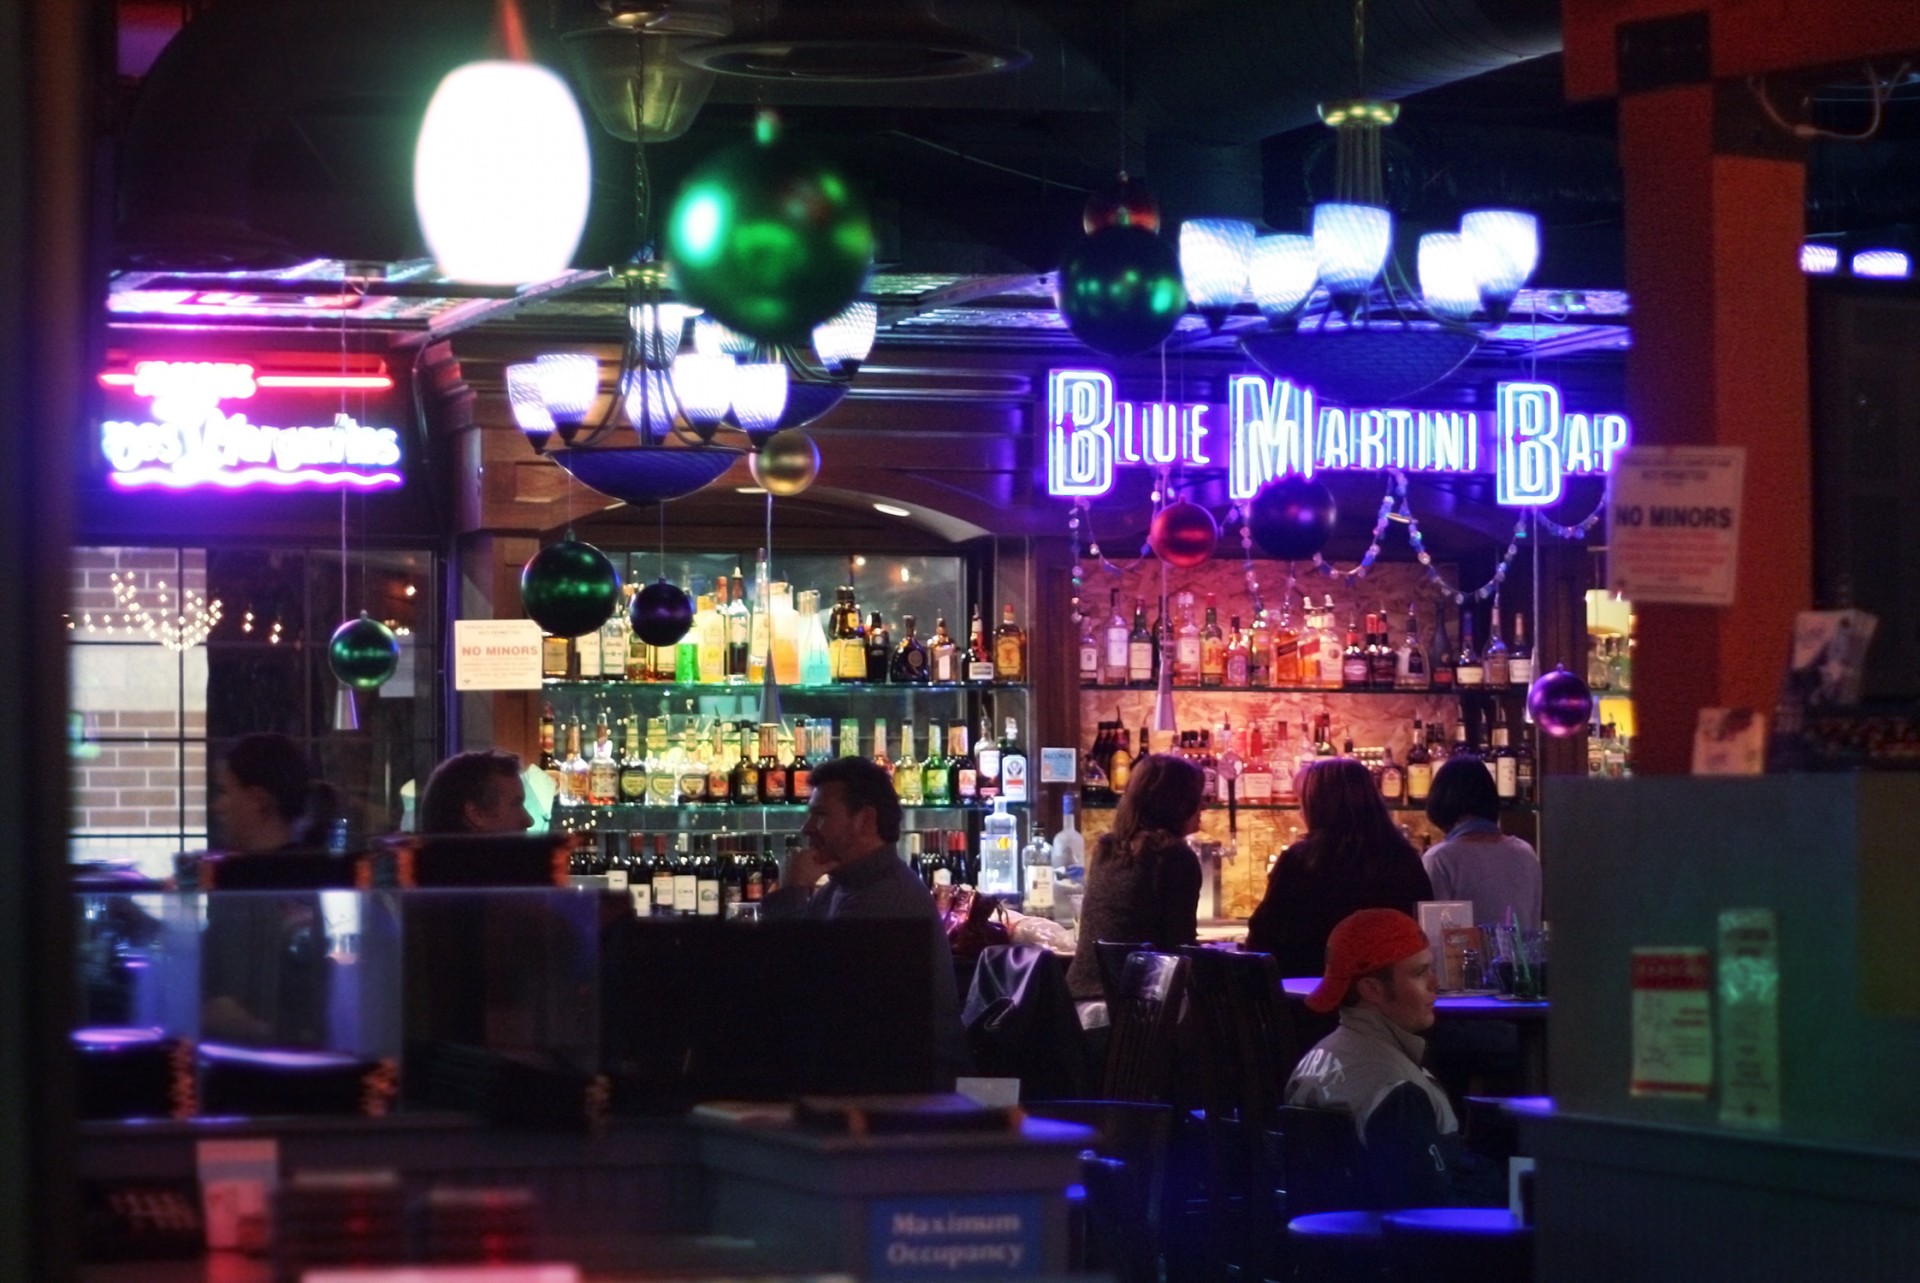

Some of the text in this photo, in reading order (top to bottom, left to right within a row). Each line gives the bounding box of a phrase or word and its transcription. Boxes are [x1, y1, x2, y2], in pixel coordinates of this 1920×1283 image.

[1049, 369, 1211, 497] BLUE
[1229, 374, 1479, 499] MARTINI
[1616, 504, 1732, 528] NO MINORS
[462, 645, 538, 656] NO MINORS
[892, 1213, 1021, 1235] Maximum
[887, 1242, 1023, 1269] Occupancy
